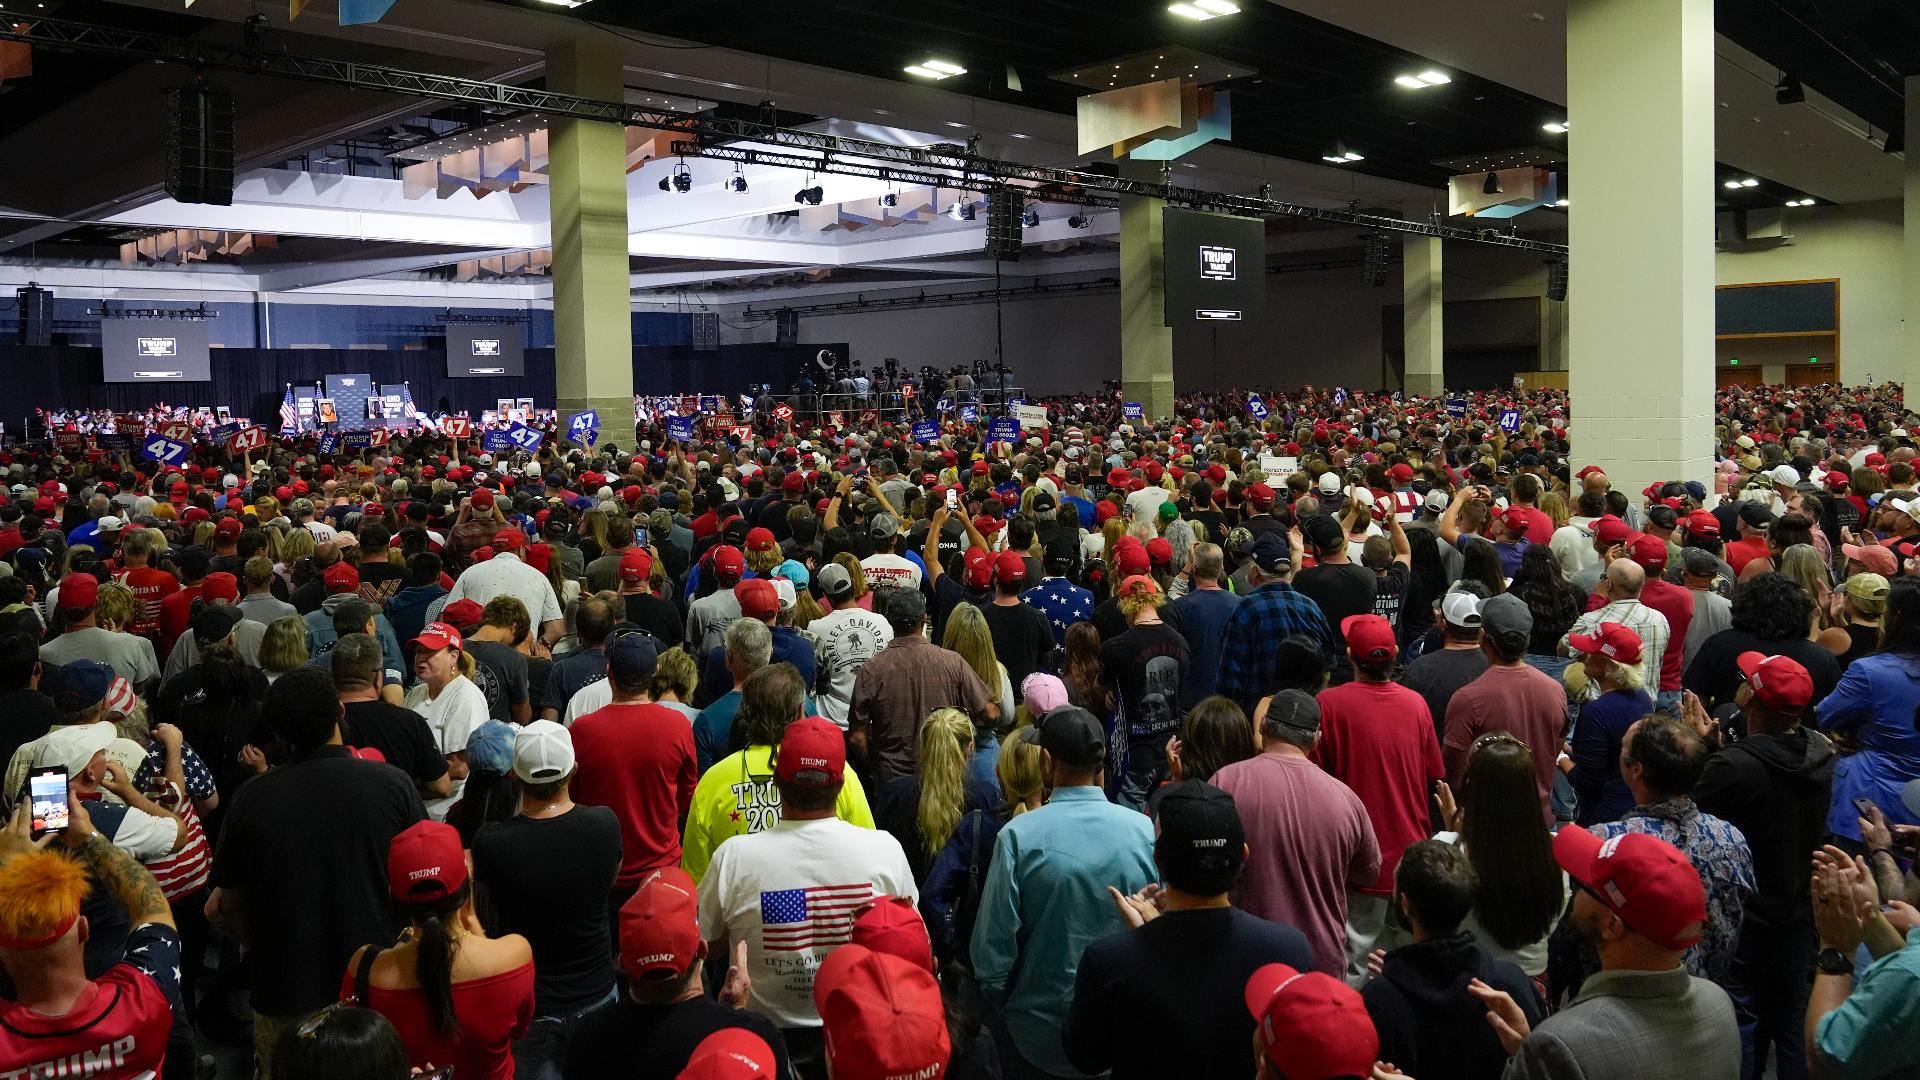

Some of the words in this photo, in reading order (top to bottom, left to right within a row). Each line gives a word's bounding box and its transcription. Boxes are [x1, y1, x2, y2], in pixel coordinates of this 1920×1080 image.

[1203, 250, 1233, 264] TRUMP
[902, 386, 912, 396] 47
[936, 399, 948, 410] 47
[1251, 401, 1268, 416] 47
[777, 407, 793, 417] 47
[447, 419, 466, 435] 47
[573, 412, 594, 430] 47
[706, 416, 716, 428] 47
[1501, 413, 1518, 428] 47
[165, 425, 189, 440] 47
[235, 428, 258, 448] 47
[510, 427, 540, 447] 47
[732, 427, 750, 440] 47
[147, 439, 183, 461] 47
[1375, 598, 1399, 609] OTING
[826, 618, 884, 664] HARLEY-DAVIDSO
[800, 757, 828, 767] TRUMP
[1192, 838, 1227, 848] TRUMP
[409, 866, 441, 881] TRUMP
[637, 953, 675, 966] TRUMP
[764, 957, 793, 968] LET'S
[795, 956, 812, 967] GO
